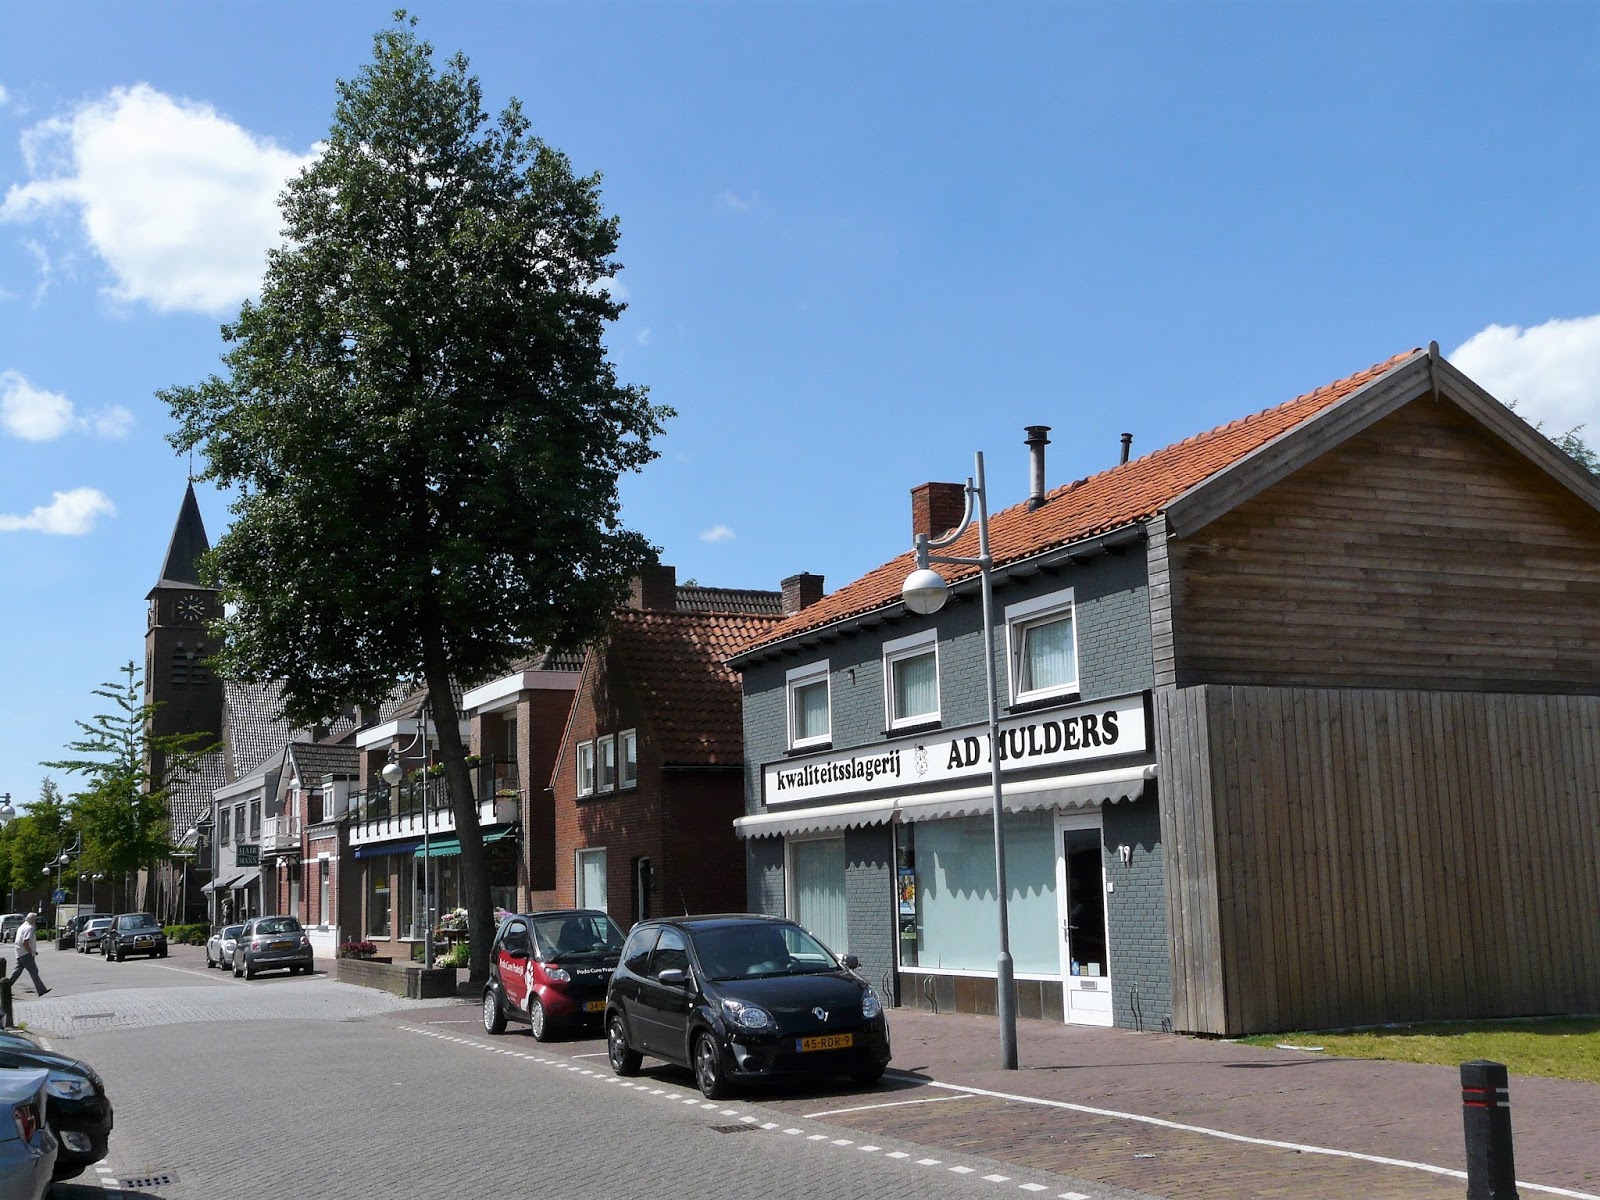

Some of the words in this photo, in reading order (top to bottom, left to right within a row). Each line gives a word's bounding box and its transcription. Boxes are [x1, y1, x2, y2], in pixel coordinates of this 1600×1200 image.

[777, 748, 901, 791] kwaliteitsslagerij
[947, 736, 981, 770] AD
[987, 710, 1119, 763] MULDERS
[239, 847, 257, 855] HAIR
[1118, 845, 1131, 862] 19
[803, 1035, 850, 1049] 45-RDR-9
